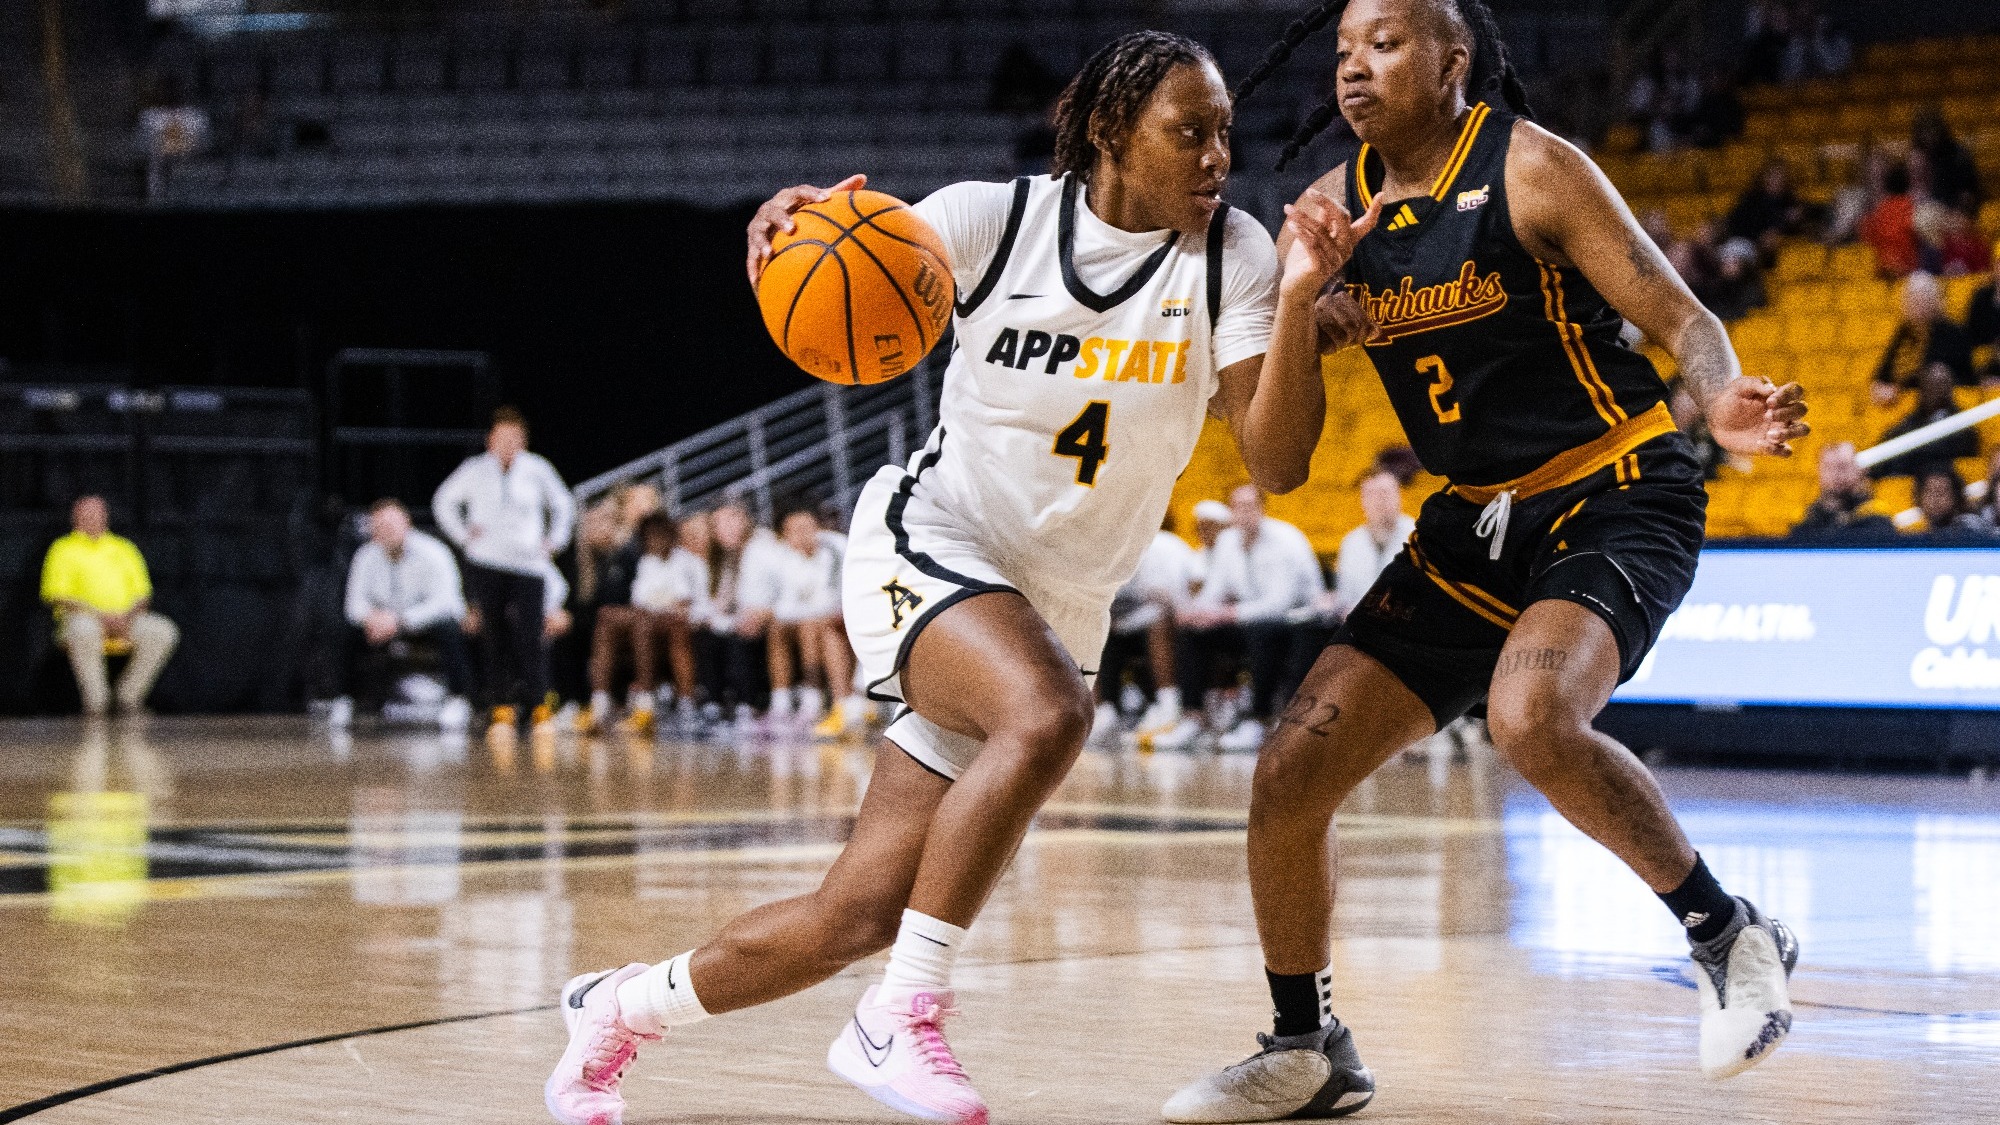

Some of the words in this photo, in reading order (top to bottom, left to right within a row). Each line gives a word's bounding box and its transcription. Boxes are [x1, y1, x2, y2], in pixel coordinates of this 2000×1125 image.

[1415, 355, 1461, 424] 2
[1052, 400, 1111, 488] 4
[881, 576, 923, 631] A
